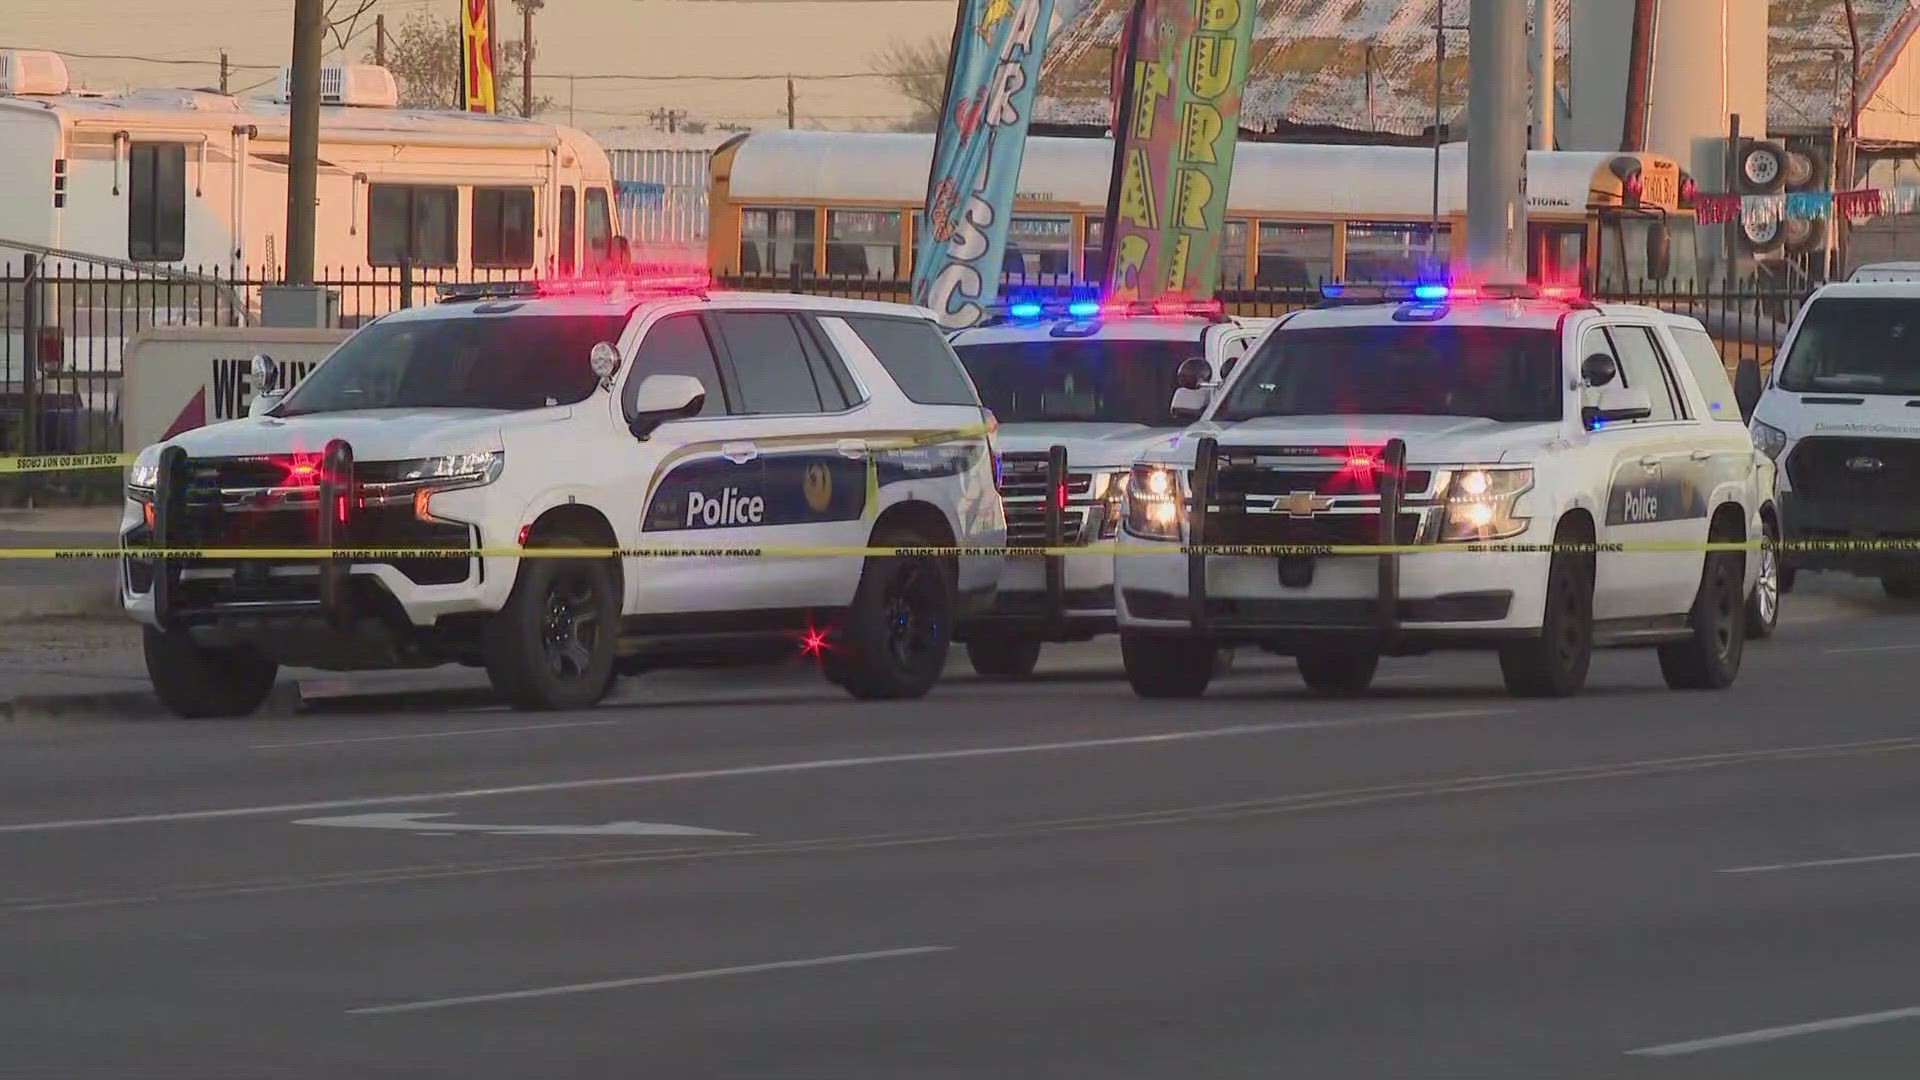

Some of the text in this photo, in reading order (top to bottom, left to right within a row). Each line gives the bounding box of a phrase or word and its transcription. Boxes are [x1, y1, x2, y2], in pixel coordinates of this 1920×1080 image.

[212, 359, 253, 420] WE
[16, 455, 117, 469] POLICE LINE DO NOT CROSS
[686, 487, 765, 528] Police
[1624, 487, 1658, 521] Police
